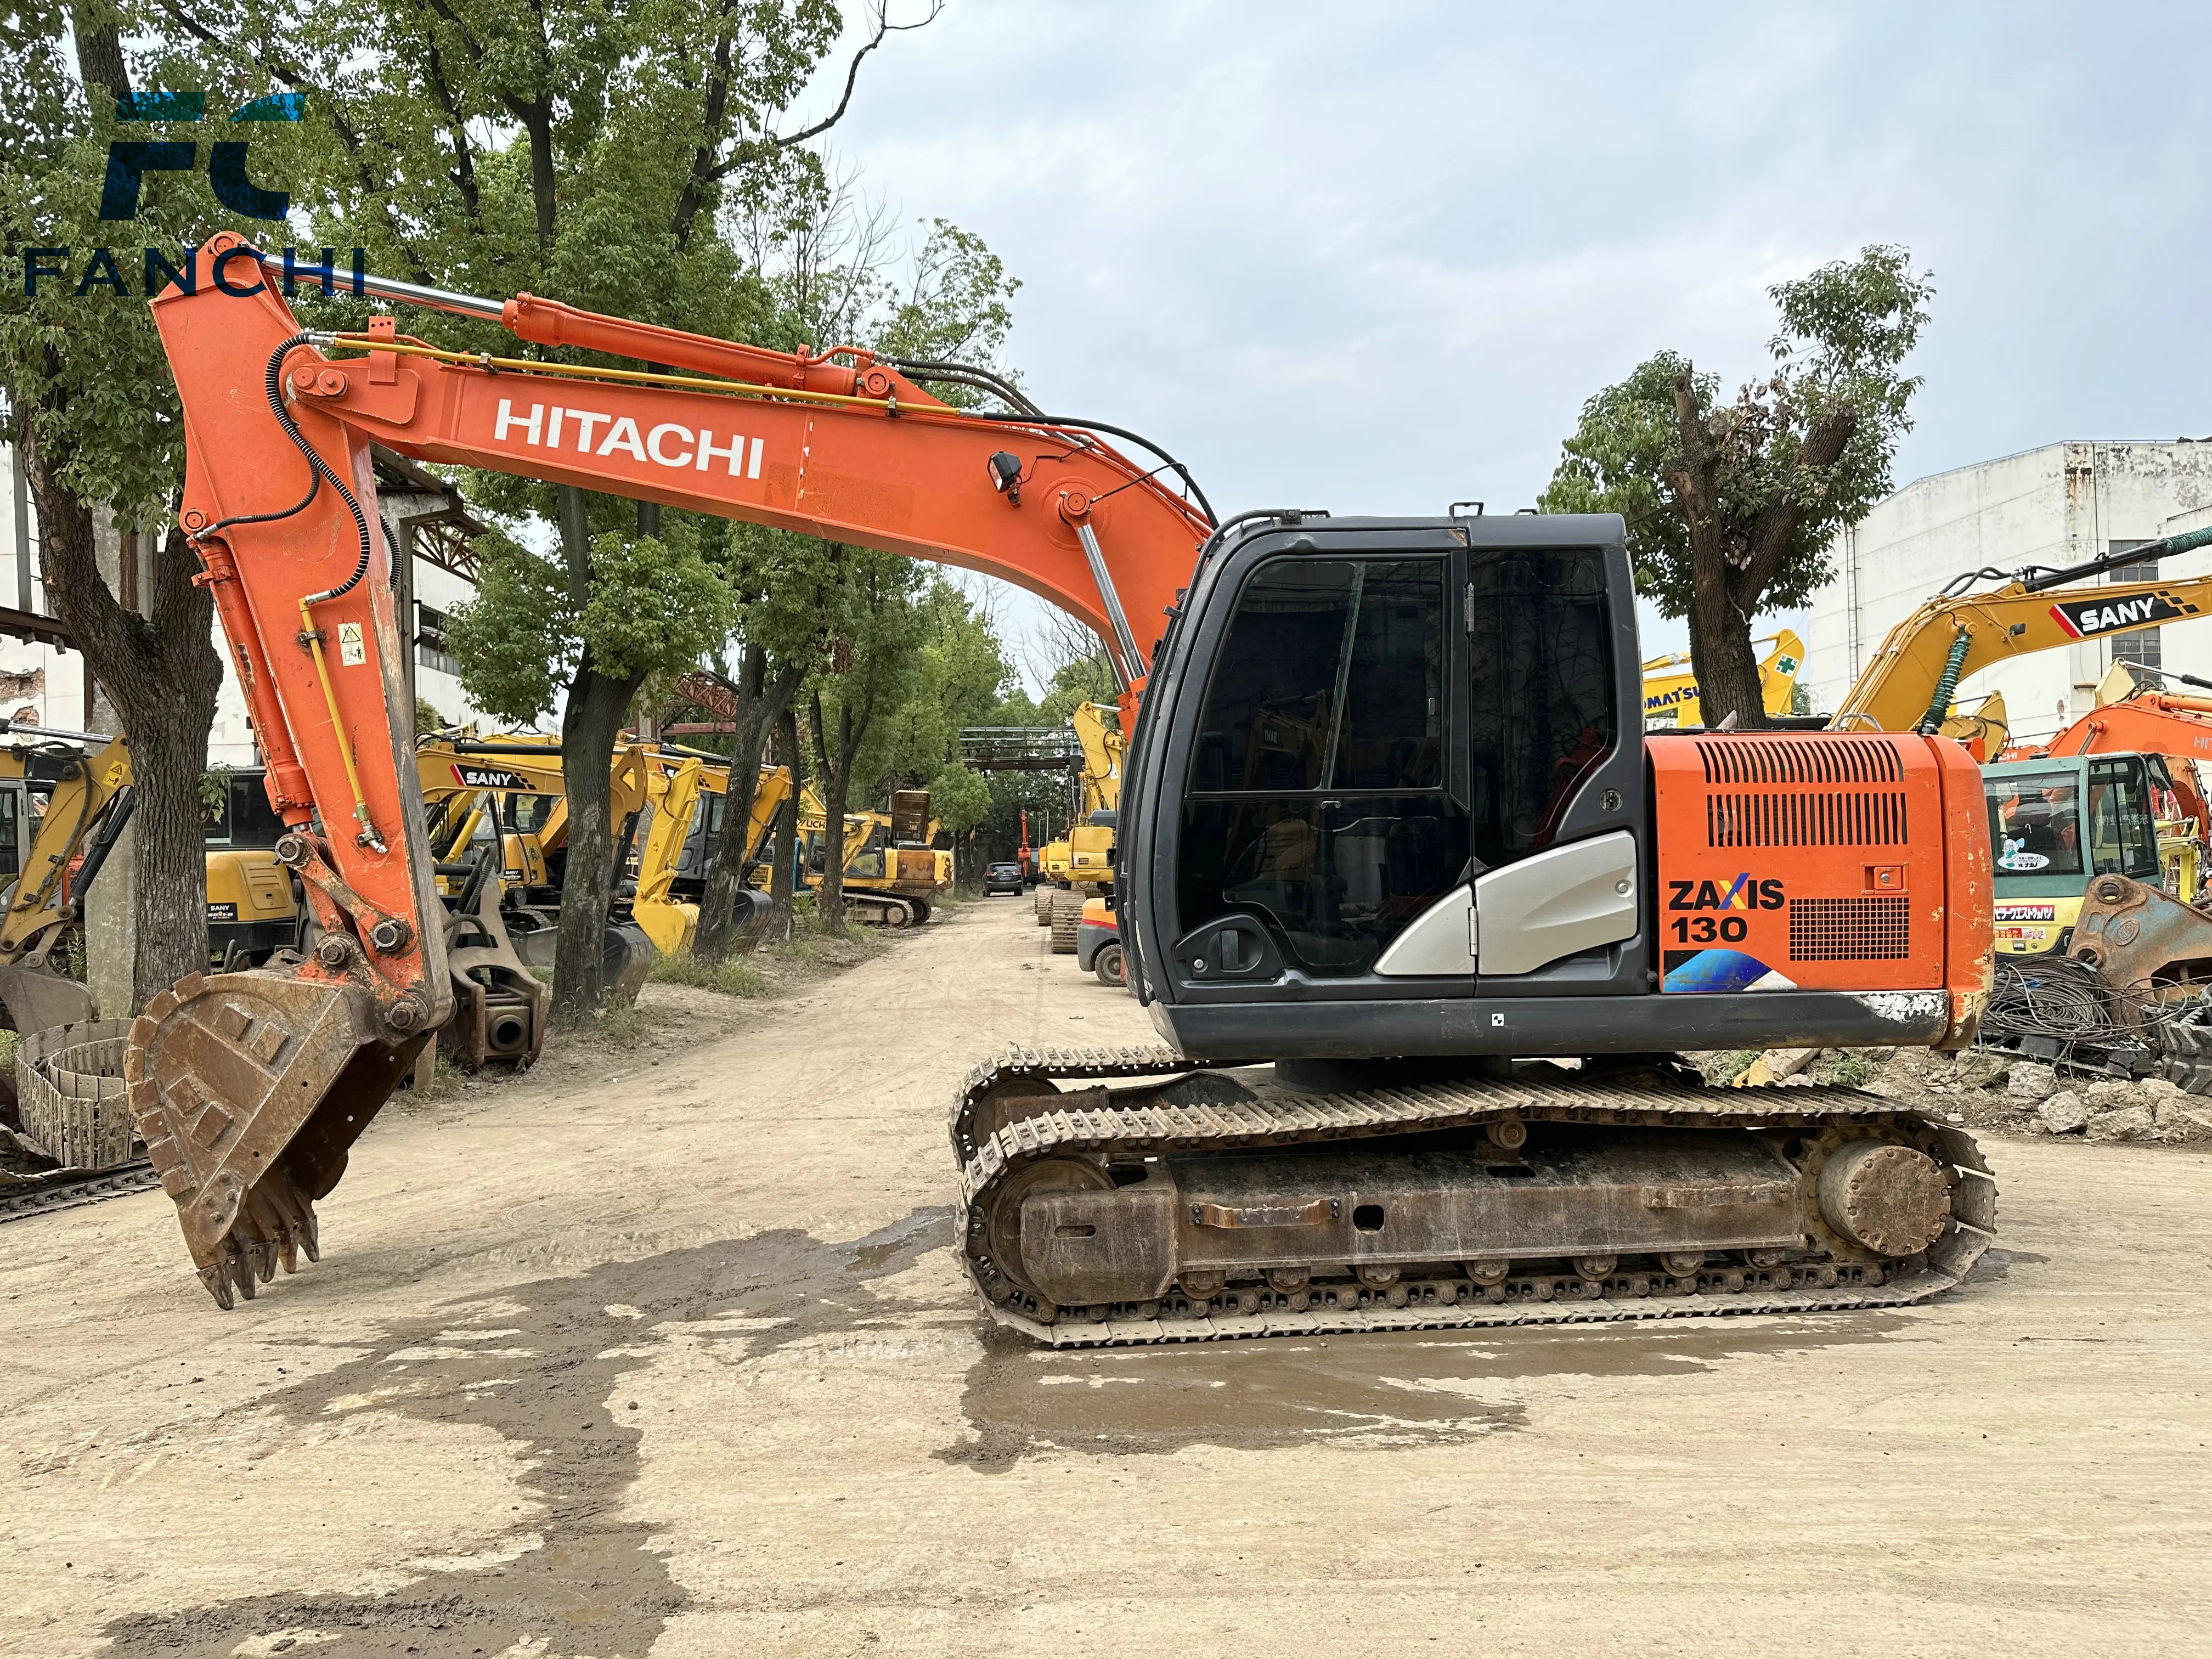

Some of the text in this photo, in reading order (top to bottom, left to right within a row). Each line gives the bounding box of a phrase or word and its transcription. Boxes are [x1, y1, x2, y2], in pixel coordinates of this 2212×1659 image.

[494, 398, 764, 479] HITACHI
[2080, 597, 2154, 632] SANY
[1644, 686, 1700, 709] MATSU
[466, 771, 512, 786] SANY
[1669, 872, 1785, 911] ZAXIS
[1671, 916, 1747, 943] 130
